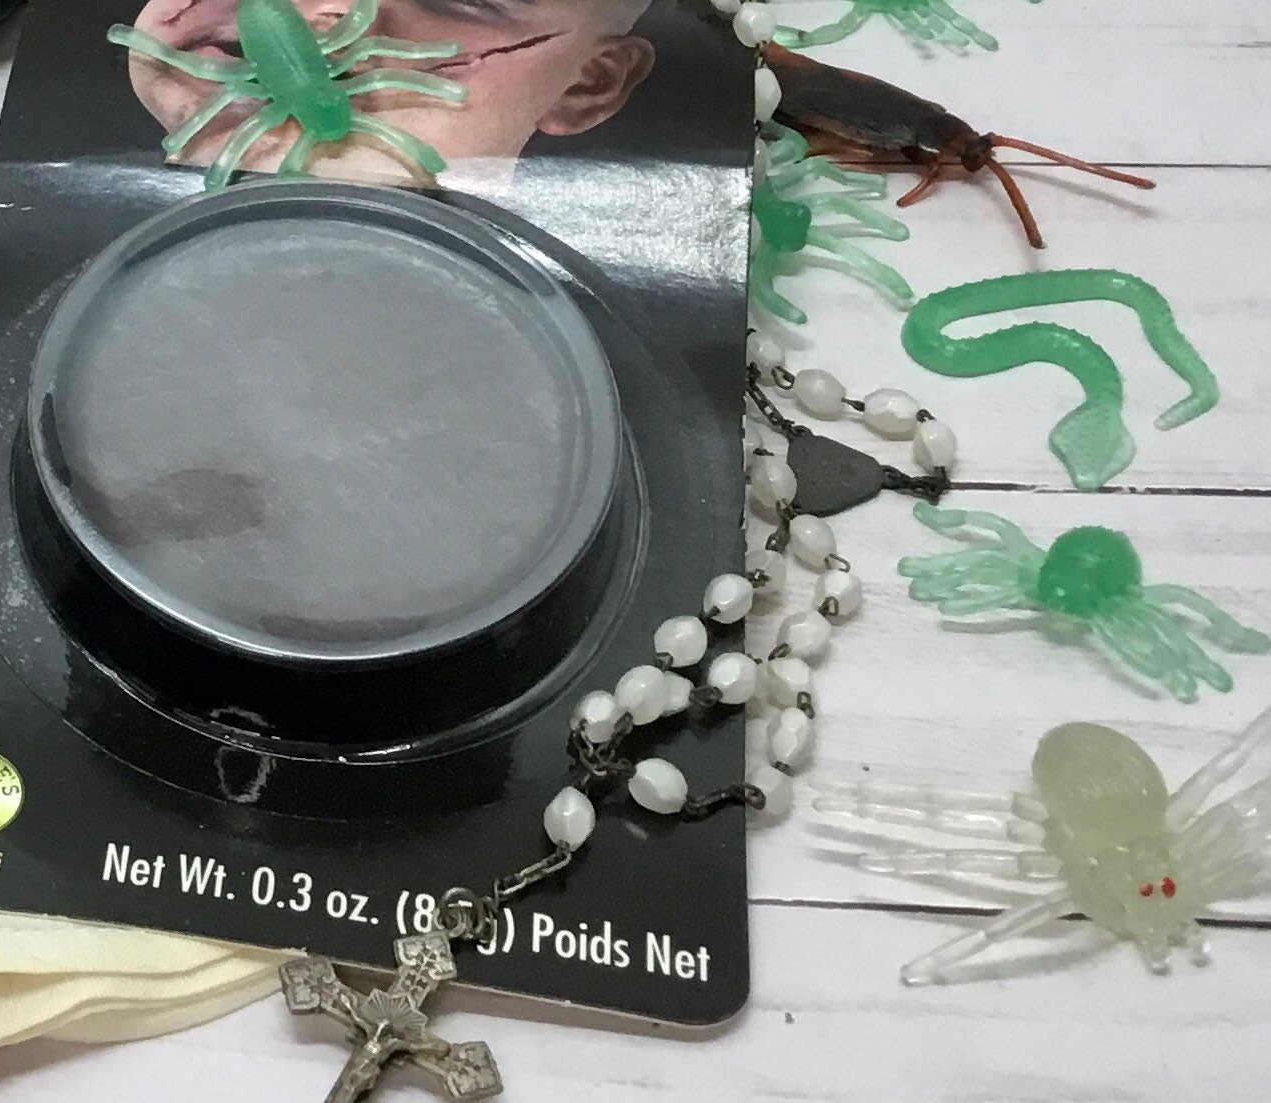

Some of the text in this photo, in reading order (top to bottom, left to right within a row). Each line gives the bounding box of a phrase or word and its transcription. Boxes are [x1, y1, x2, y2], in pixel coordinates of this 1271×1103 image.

[102, 842, 166, 888] Net
[179, 853, 235, 900] Wt.
[251, 866, 313, 912] 0.3
[326, 890, 380, 925] oz.
[531, 912, 631, 968] Poids
[645, 931, 711, 982] Net
